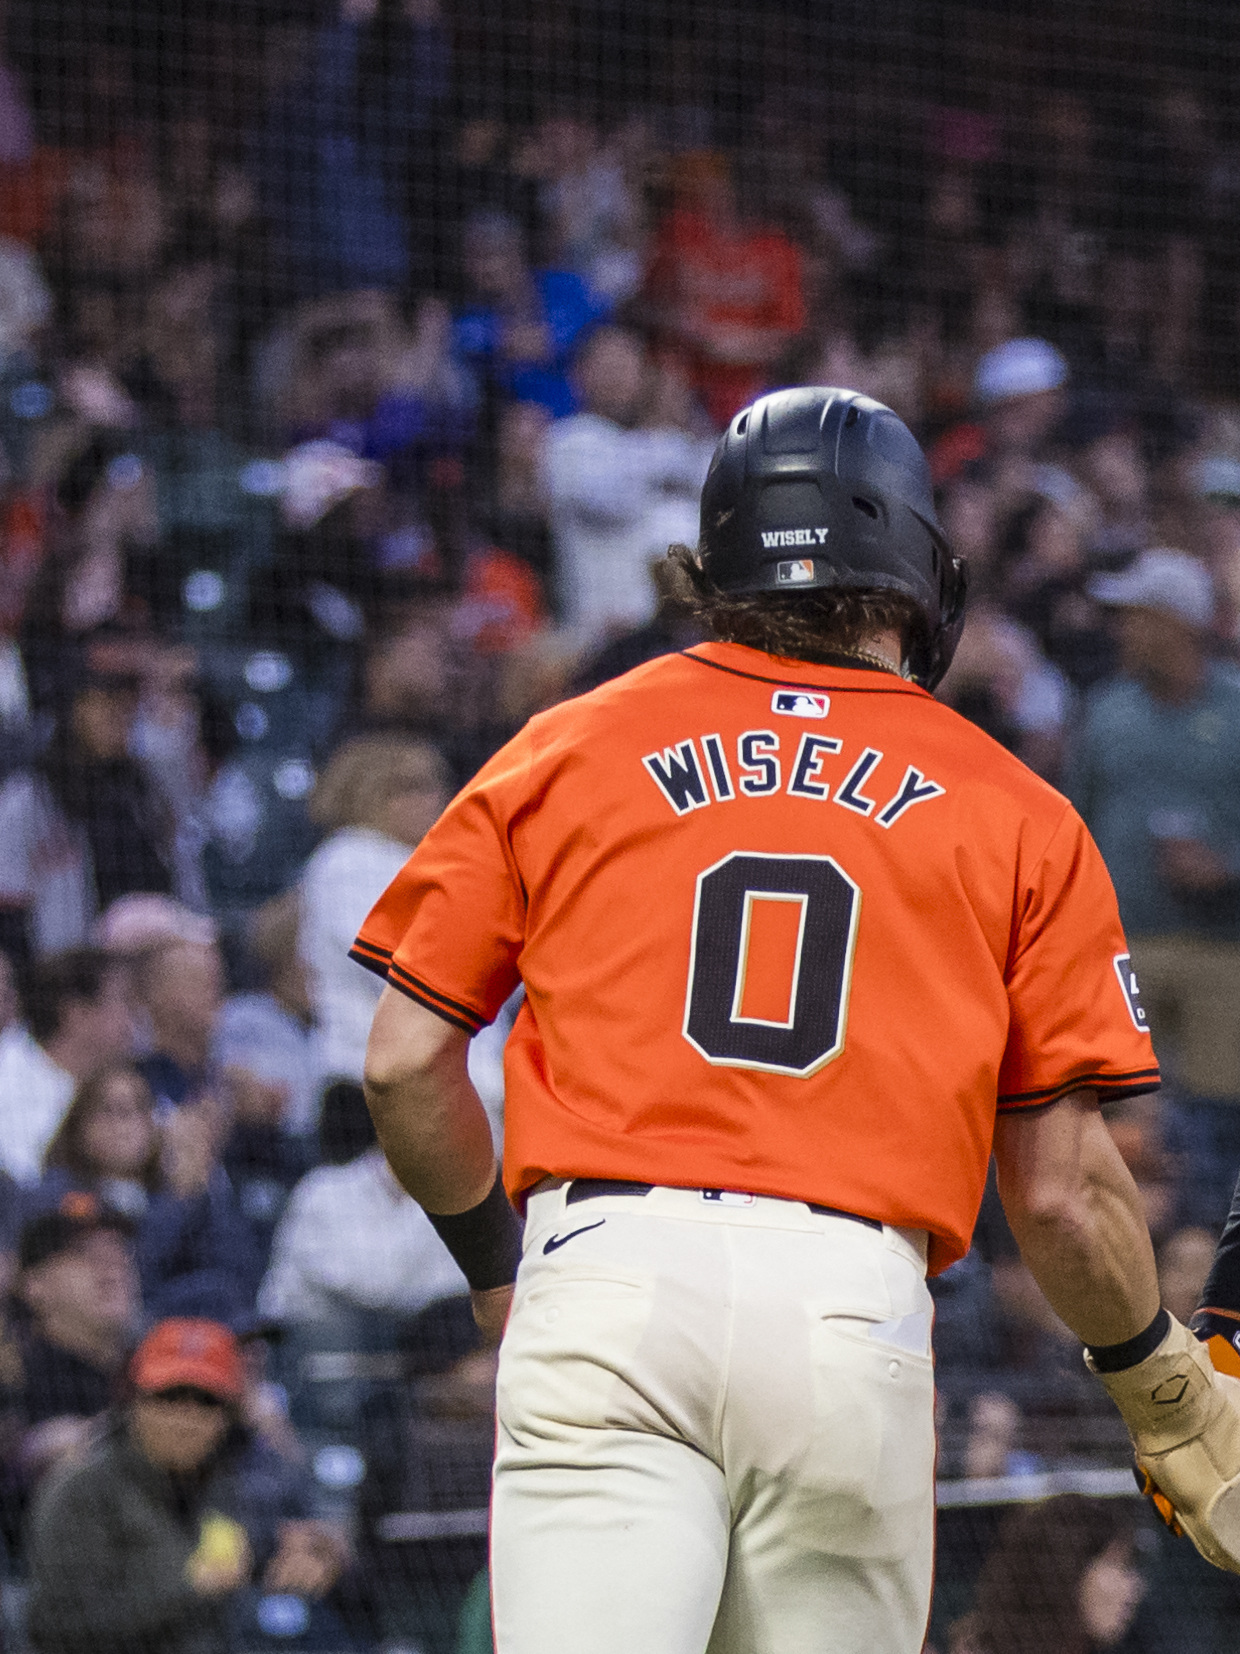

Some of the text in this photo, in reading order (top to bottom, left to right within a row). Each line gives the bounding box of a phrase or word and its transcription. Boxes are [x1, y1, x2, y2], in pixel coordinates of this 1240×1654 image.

[761, 528, 828, 548] WISELY
[641, 730, 946, 829] WISELY
[682, 850, 863, 1080] 0
